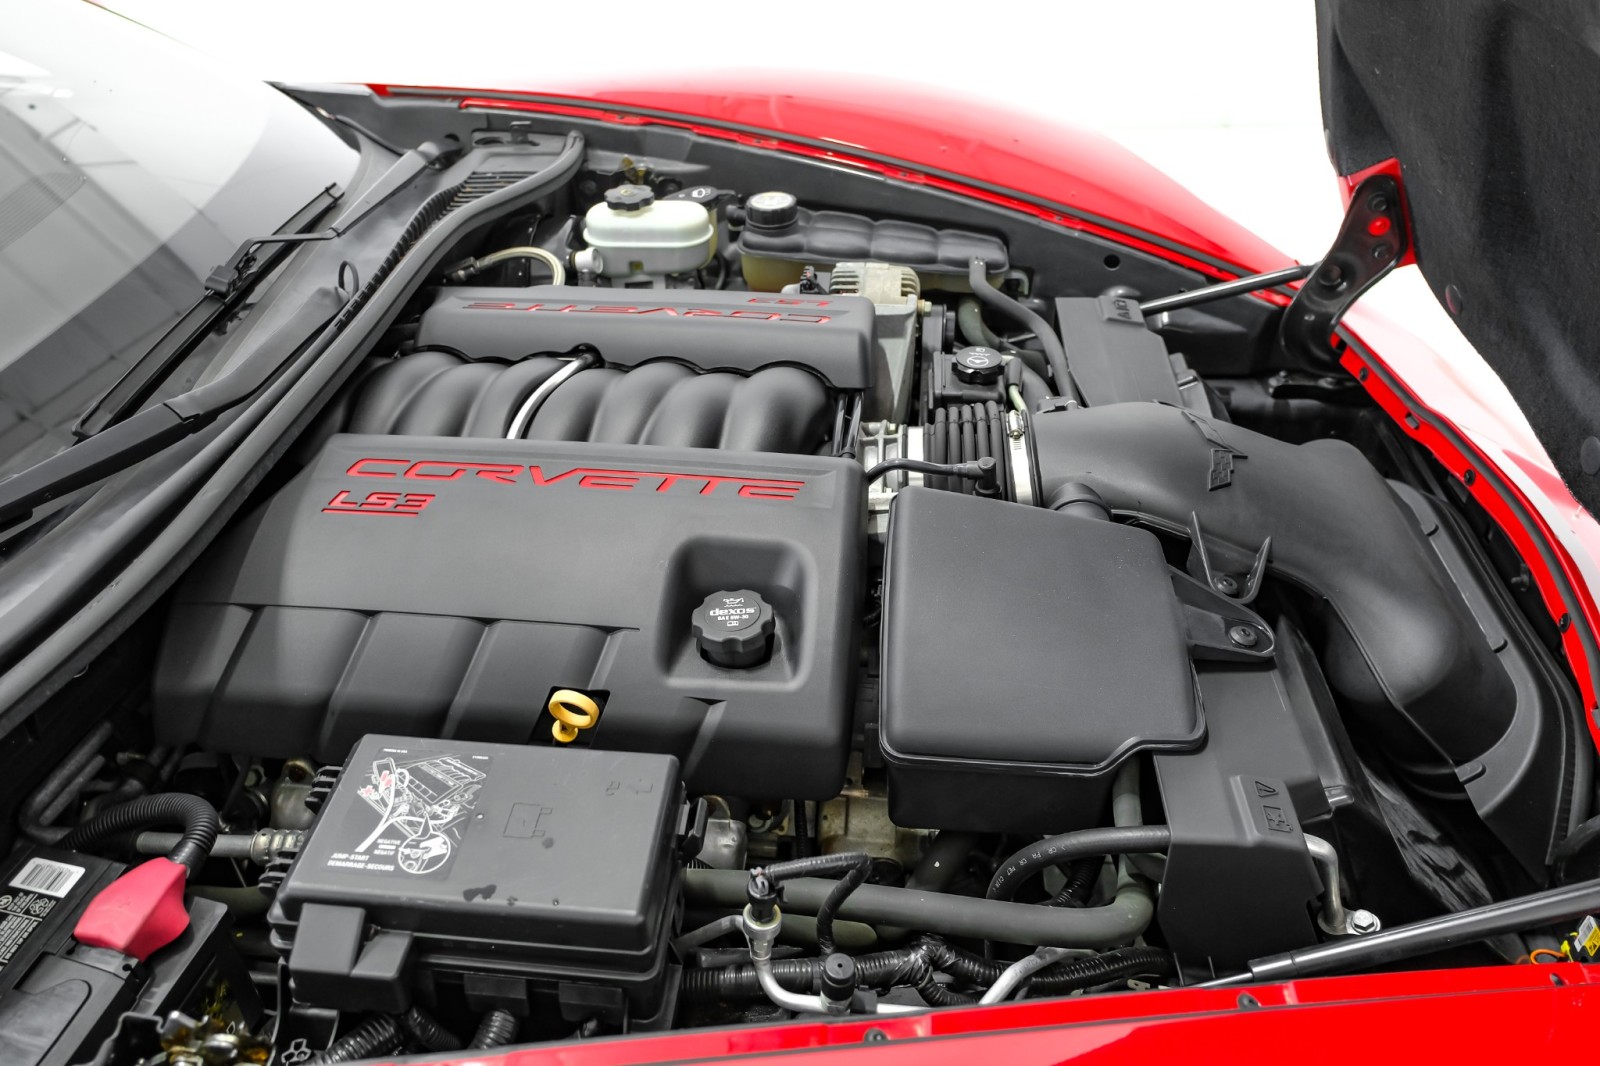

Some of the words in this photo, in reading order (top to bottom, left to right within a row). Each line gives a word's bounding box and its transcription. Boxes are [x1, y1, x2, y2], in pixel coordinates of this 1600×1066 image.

[346, 458, 805, 501] CORVETTE
[326, 490, 436, 512] LS3
[709, 608, 755, 616] dexos
